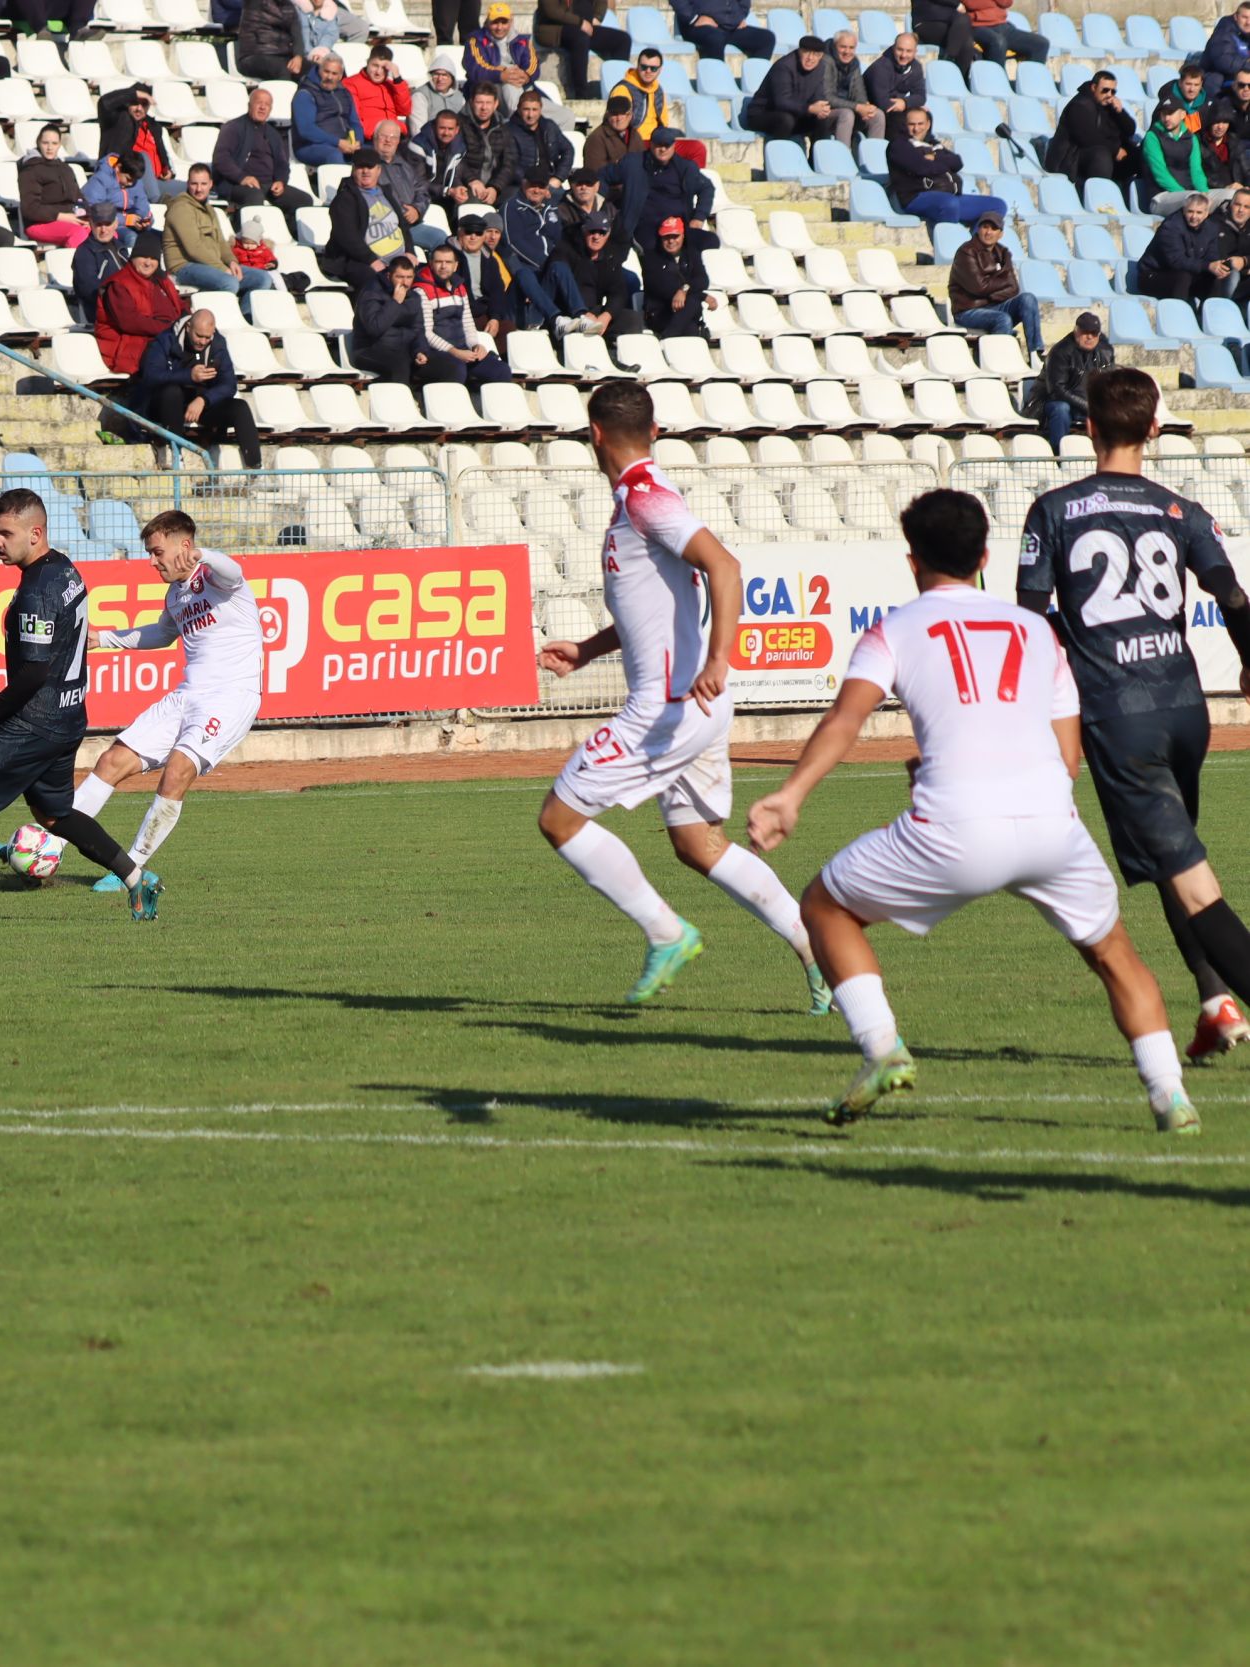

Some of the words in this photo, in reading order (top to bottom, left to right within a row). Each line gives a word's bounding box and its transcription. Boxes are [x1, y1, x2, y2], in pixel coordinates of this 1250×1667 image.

[740, 576, 796, 616] GA
[808, 575, 832, 615] 2
[1069, 529, 1183, 628] 28
[182, 612, 217, 637] ATINA
[322, 569, 507, 643] casa
[765, 627, 816, 649] casa
[766, 649, 815, 664] pariurilor
[322, 640, 504, 691] pariurilor
[927, 619, 1028, 704] 17
[59, 687, 88, 709] MEW
[204, 716, 222, 737] 8
[585, 726, 625, 765] 97
